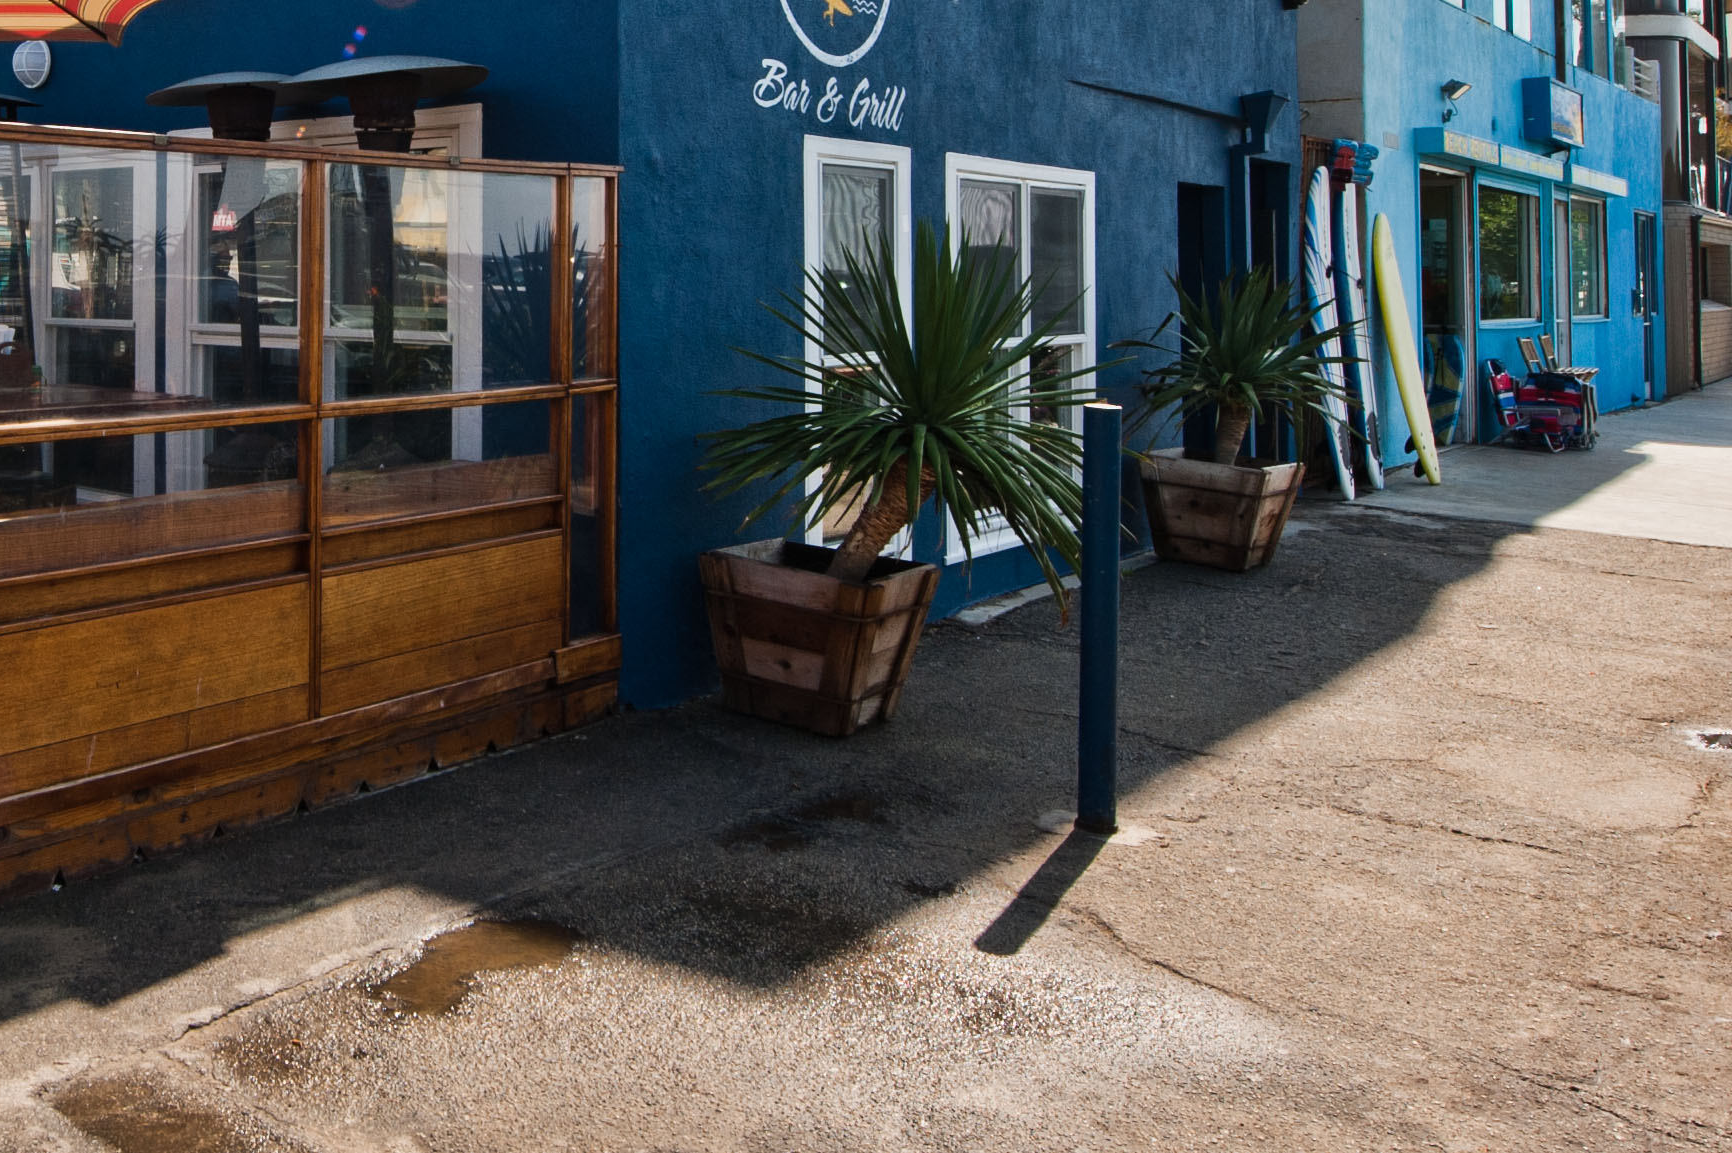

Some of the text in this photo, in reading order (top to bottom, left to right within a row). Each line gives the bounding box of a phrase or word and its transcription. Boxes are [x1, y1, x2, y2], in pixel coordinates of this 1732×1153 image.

[753, 58, 907, 132] Bar & Grill
